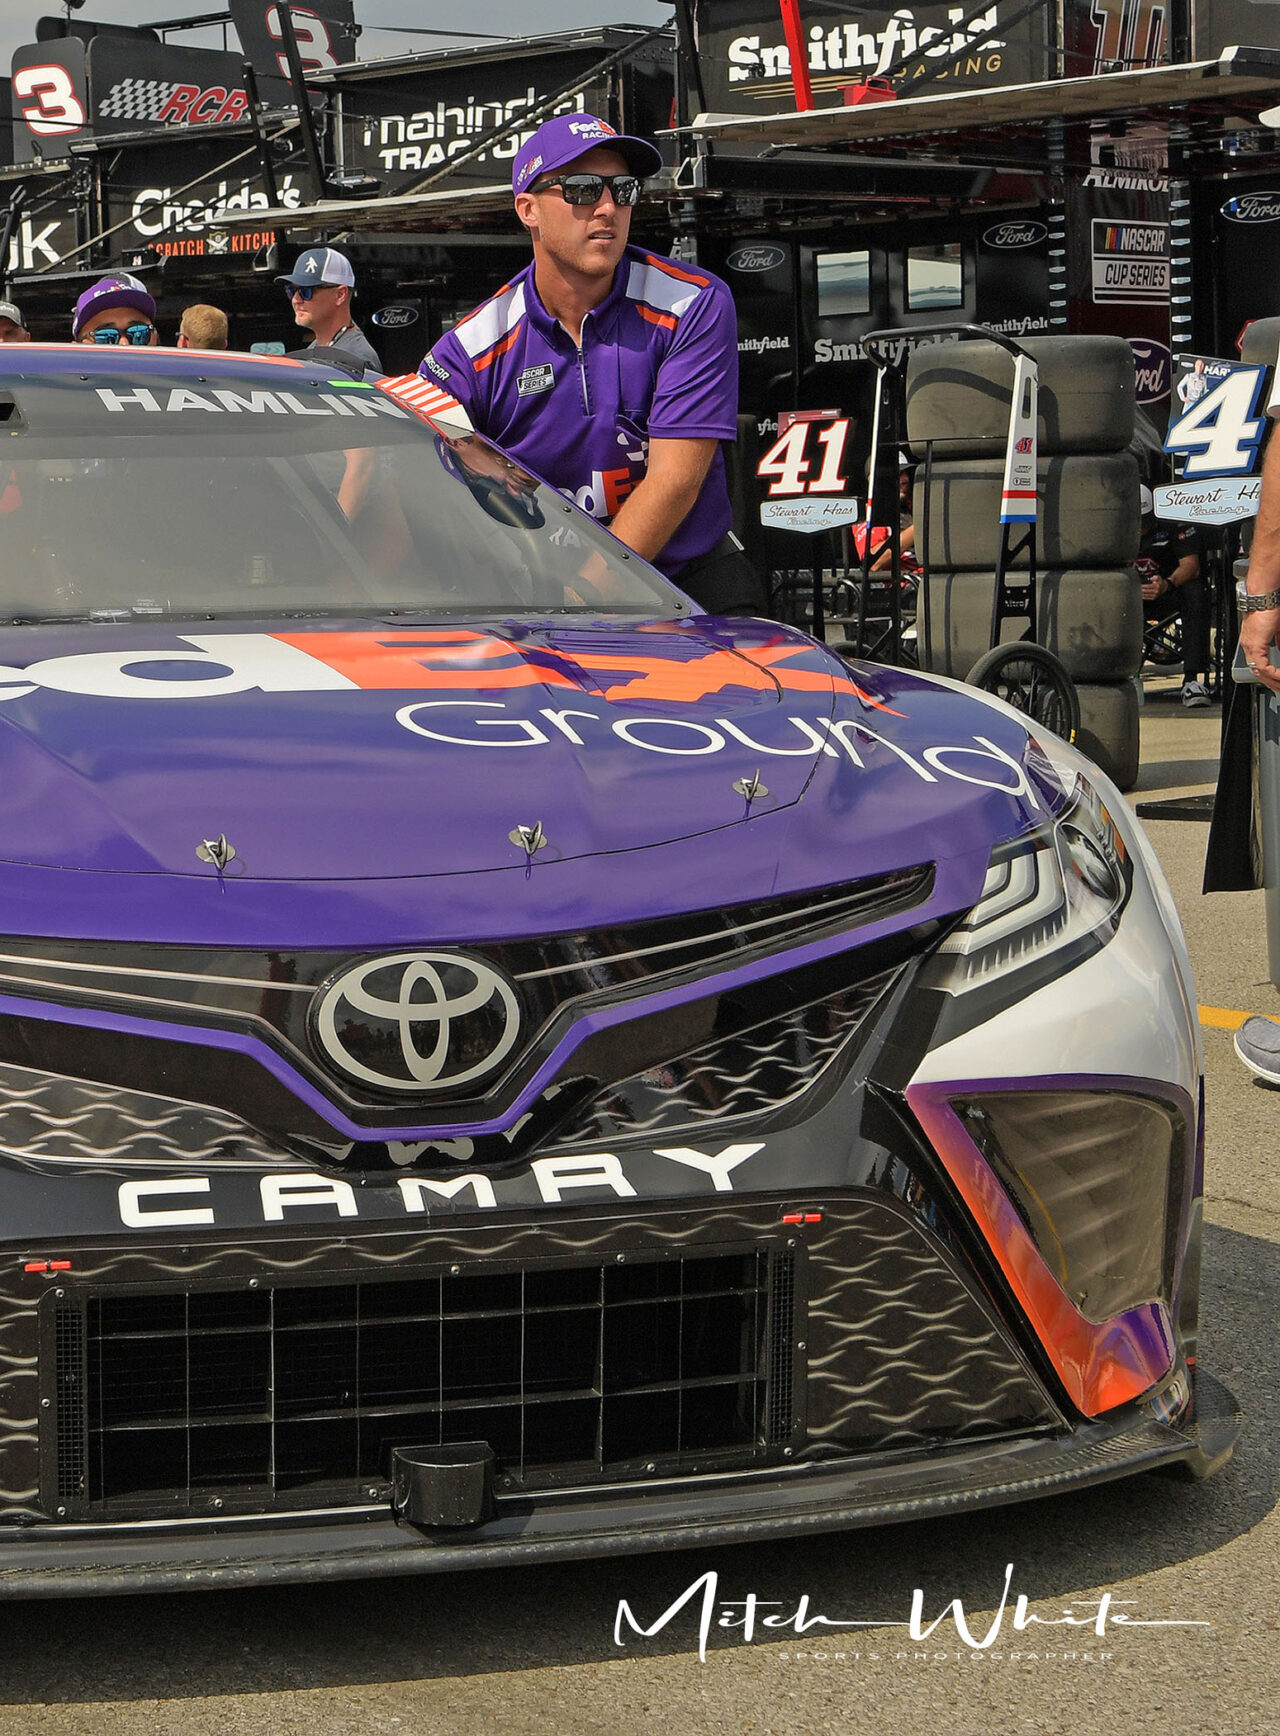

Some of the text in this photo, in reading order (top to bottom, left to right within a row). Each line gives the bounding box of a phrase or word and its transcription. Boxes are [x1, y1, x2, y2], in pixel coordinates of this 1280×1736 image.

[13, 64, 86, 137] 3
[157, 83, 250, 122] RCR
[995, 227, 1035, 245] Ford
[1120, 227, 1166, 252] NASCAR
[738, 249, 774, 268] Ford
[1105, 263, 1166, 287] CUP SERIES
[381, 309, 410, 325] Ford
[95, 388, 412, 419] HAMLIN
[1163, 366, 1263, 476] 4
[757, 418, 849, 495] 41
[765, 502, 853, 518] Stewart Haas
[1159, 489, 1228, 508] Stewart
[394, 700, 1040, 809] Ground
[118, 1142, 766, 1228] CAMRY
